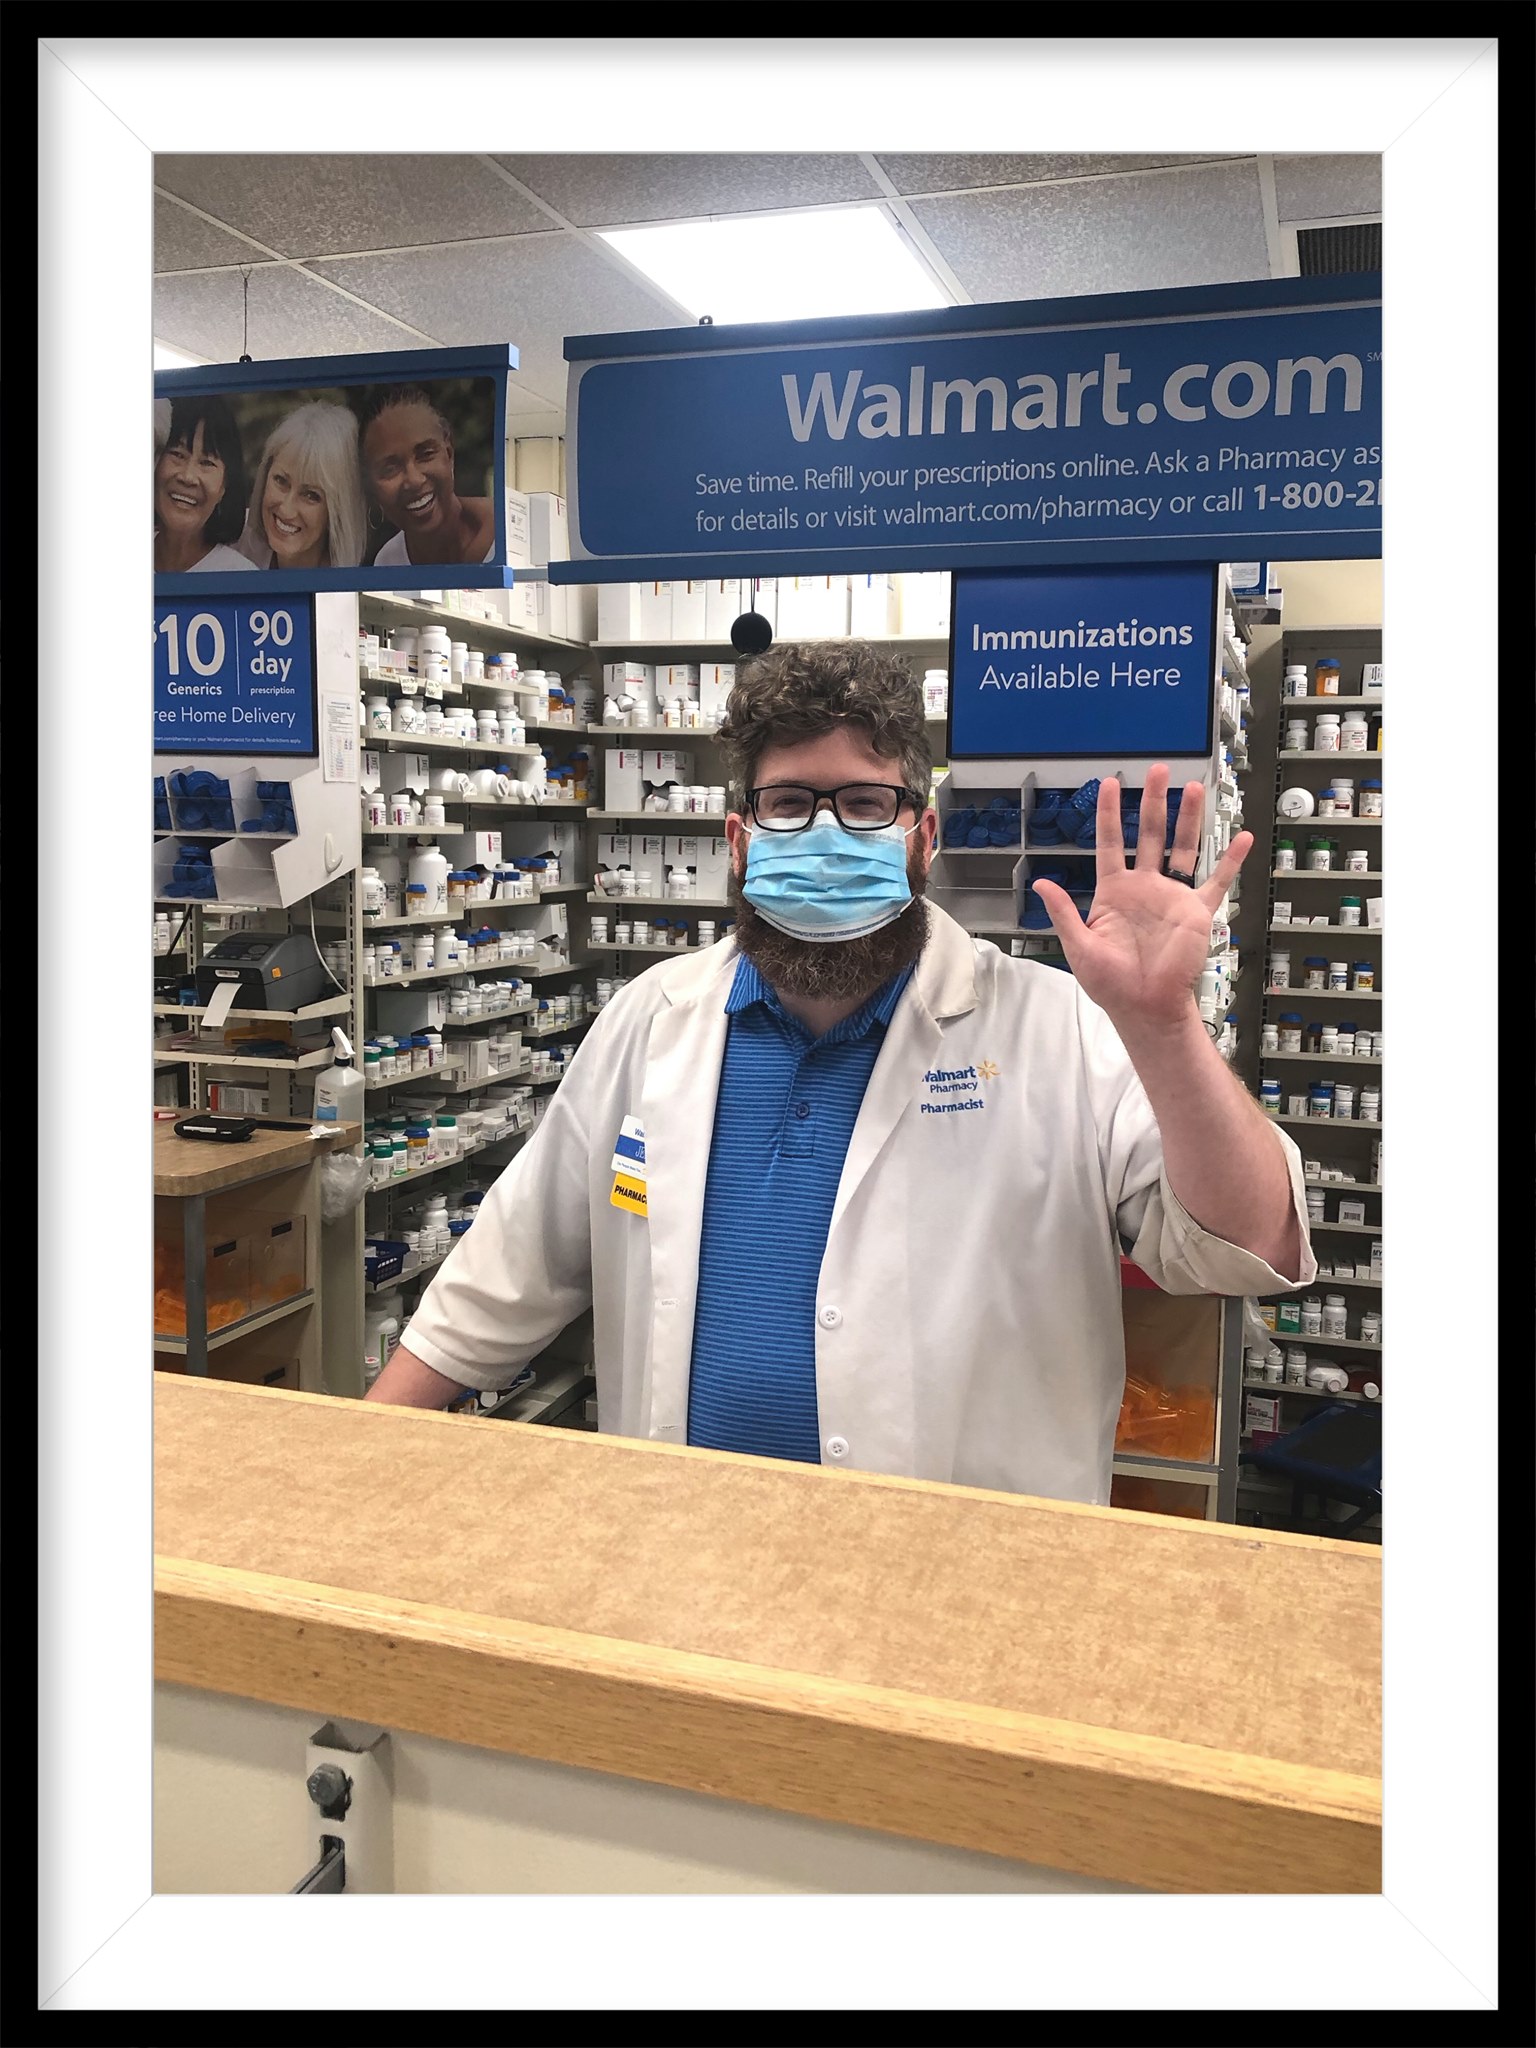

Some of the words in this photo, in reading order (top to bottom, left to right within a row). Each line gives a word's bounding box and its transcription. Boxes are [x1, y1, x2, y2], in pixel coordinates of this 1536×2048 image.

[781, 353, 1364, 443] Walmart.com
[695, 473, 743, 496] Save
[747, 471, 799, 493] time.
[804, 465, 854, 490] Refill
[859, 468, 909, 494] your
[914, 458, 1057, 491] prescriptions
[1062, 452, 1140, 479] online.
[1144, 448, 1190, 475] Ask
[1195, 454, 1210, 473] a
[1218, 446, 1347, 473] Pharmacy
[1353, 446, 1382, 465] as
[695, 510, 725, 532] for
[730, 505, 800, 532] details
[805, 511, 829, 529] or
[833, 503, 877, 528] visit
[883, 494, 1163, 526] walmart.com/pharmacy
[1168, 495, 1197, 515] or
[1202, 486, 1244, 513] call
[1253, 478, 1382, 511] 1-800-2
[248, 609, 295, 648] 90
[972, 618, 1194, 652] Immunizations
[249, 650, 293, 683] day
[978, 662, 1101, 691] Available
[1110, 661, 1182, 688] Here
[167, 681, 222, 695] Generics
[250, 686, 295, 696] prescription
[154, 710, 177, 723] ree
[180, 706, 227, 724] Home
[231, 706, 296, 729] Delivery
[930, 1082, 978, 1093] Pharmacy
[921, 1099, 984, 1113] Pharmacist
